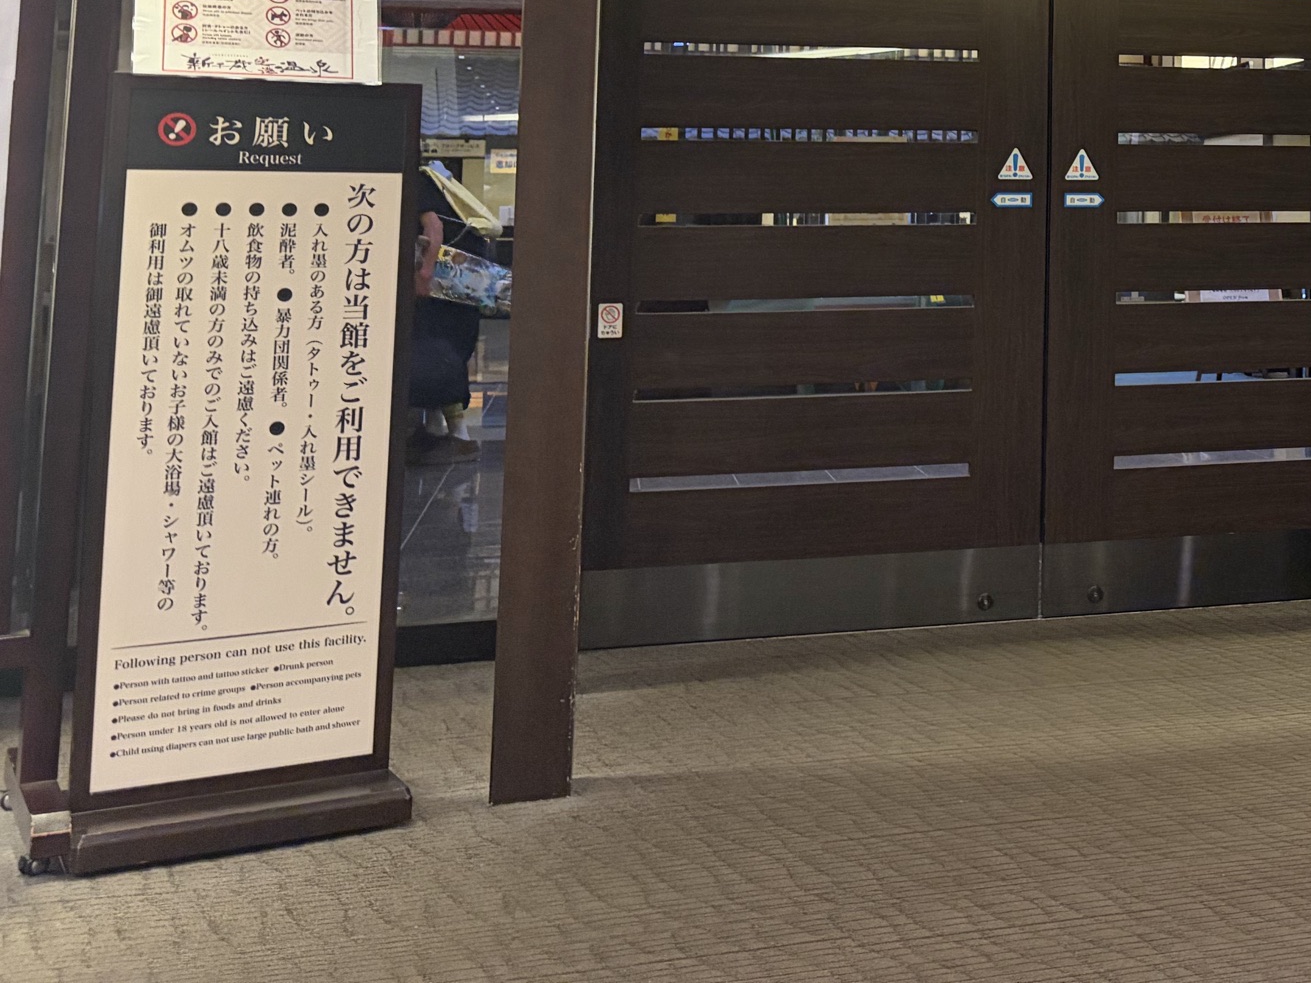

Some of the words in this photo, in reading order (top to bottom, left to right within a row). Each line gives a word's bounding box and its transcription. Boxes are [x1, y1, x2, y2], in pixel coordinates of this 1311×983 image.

[208, 116, 334, 148] お願い
[238, 151, 302, 167] Request
[277, 223, 297, 276] 泥酔者。
[136, 222, 167, 455] 御利用は御遠慮頂いております。
[233, 222, 264, 482] 飲食物の持ち込みはご遠慮ください。
[271, 308, 292, 408] 暴力団関係者。
[157, 222, 197, 611] オムツの取れていないお子様の大浴場・シャワー等の
[327, 183, 376, 616] 次の方は当館をご利用できません。
[191, 222, 231, 631] 十八歳未満の方のみでのご入館はご遠慮頂いております。
[262, 442, 286, 559] ペット連れの方。
[114, 656, 176, 670] Following
[180, 651, 221, 665] person
[225, 647, 247, 657] can
[251, 645, 271, 655] not
[275, 644, 295, 652] use
[299, 639, 320, 650] this
[324, 634, 367, 647] facility.
[120, 680, 149, 689] Person
[151, 677, 170, 686] with
[171, 676, 196, 684] tattoo
[198, 672, 214, 681] and
[241, 667, 269, 676] sticker
[280, 661, 304, 671] Drunk
[306, 659, 334, 669] person
[118, 715, 145, 723] Please
[161, 710, 175, 718] not
[177, 707, 200, 716] bring
[213, 702, 235, 711] foods
[237, 700, 253, 709] and
[255, 697, 282, 706] drinks
[119, 697, 148, 706] Person
[150, 693, 180, 703] related
[192, 688, 216, 697] crime
[217, 685, 246, 696] groups
[256, 681, 284, 690] Person
[286, 673, 344, 686] accompanying
[345, 671, 362, 681] pets
[116, 747, 139, 757] Child
[141, 744, 164, 754] using
[165, 740, 197, 751] diapers
[198, 739, 214, 747] can
[231, 735, 245, 743] use
[247, 731, 267, 741] large
[268, 727, 294, 739] public
[296, 724, 314, 734] bath
[315, 723, 331, 731] and
[332, 719, 361, 729] shower
[117, 731, 146, 740] Person
[149, 728, 174, 736] under
[177, 725, 187, 733] 18
[189, 722, 212, 732] years
[214, 719, 228, 728] old
[230, 718, 237, 726] is
[255, 712, 287, 723] allowed
[300, 708, 321, 717] enter
[323, 705, 345, 714] alone
